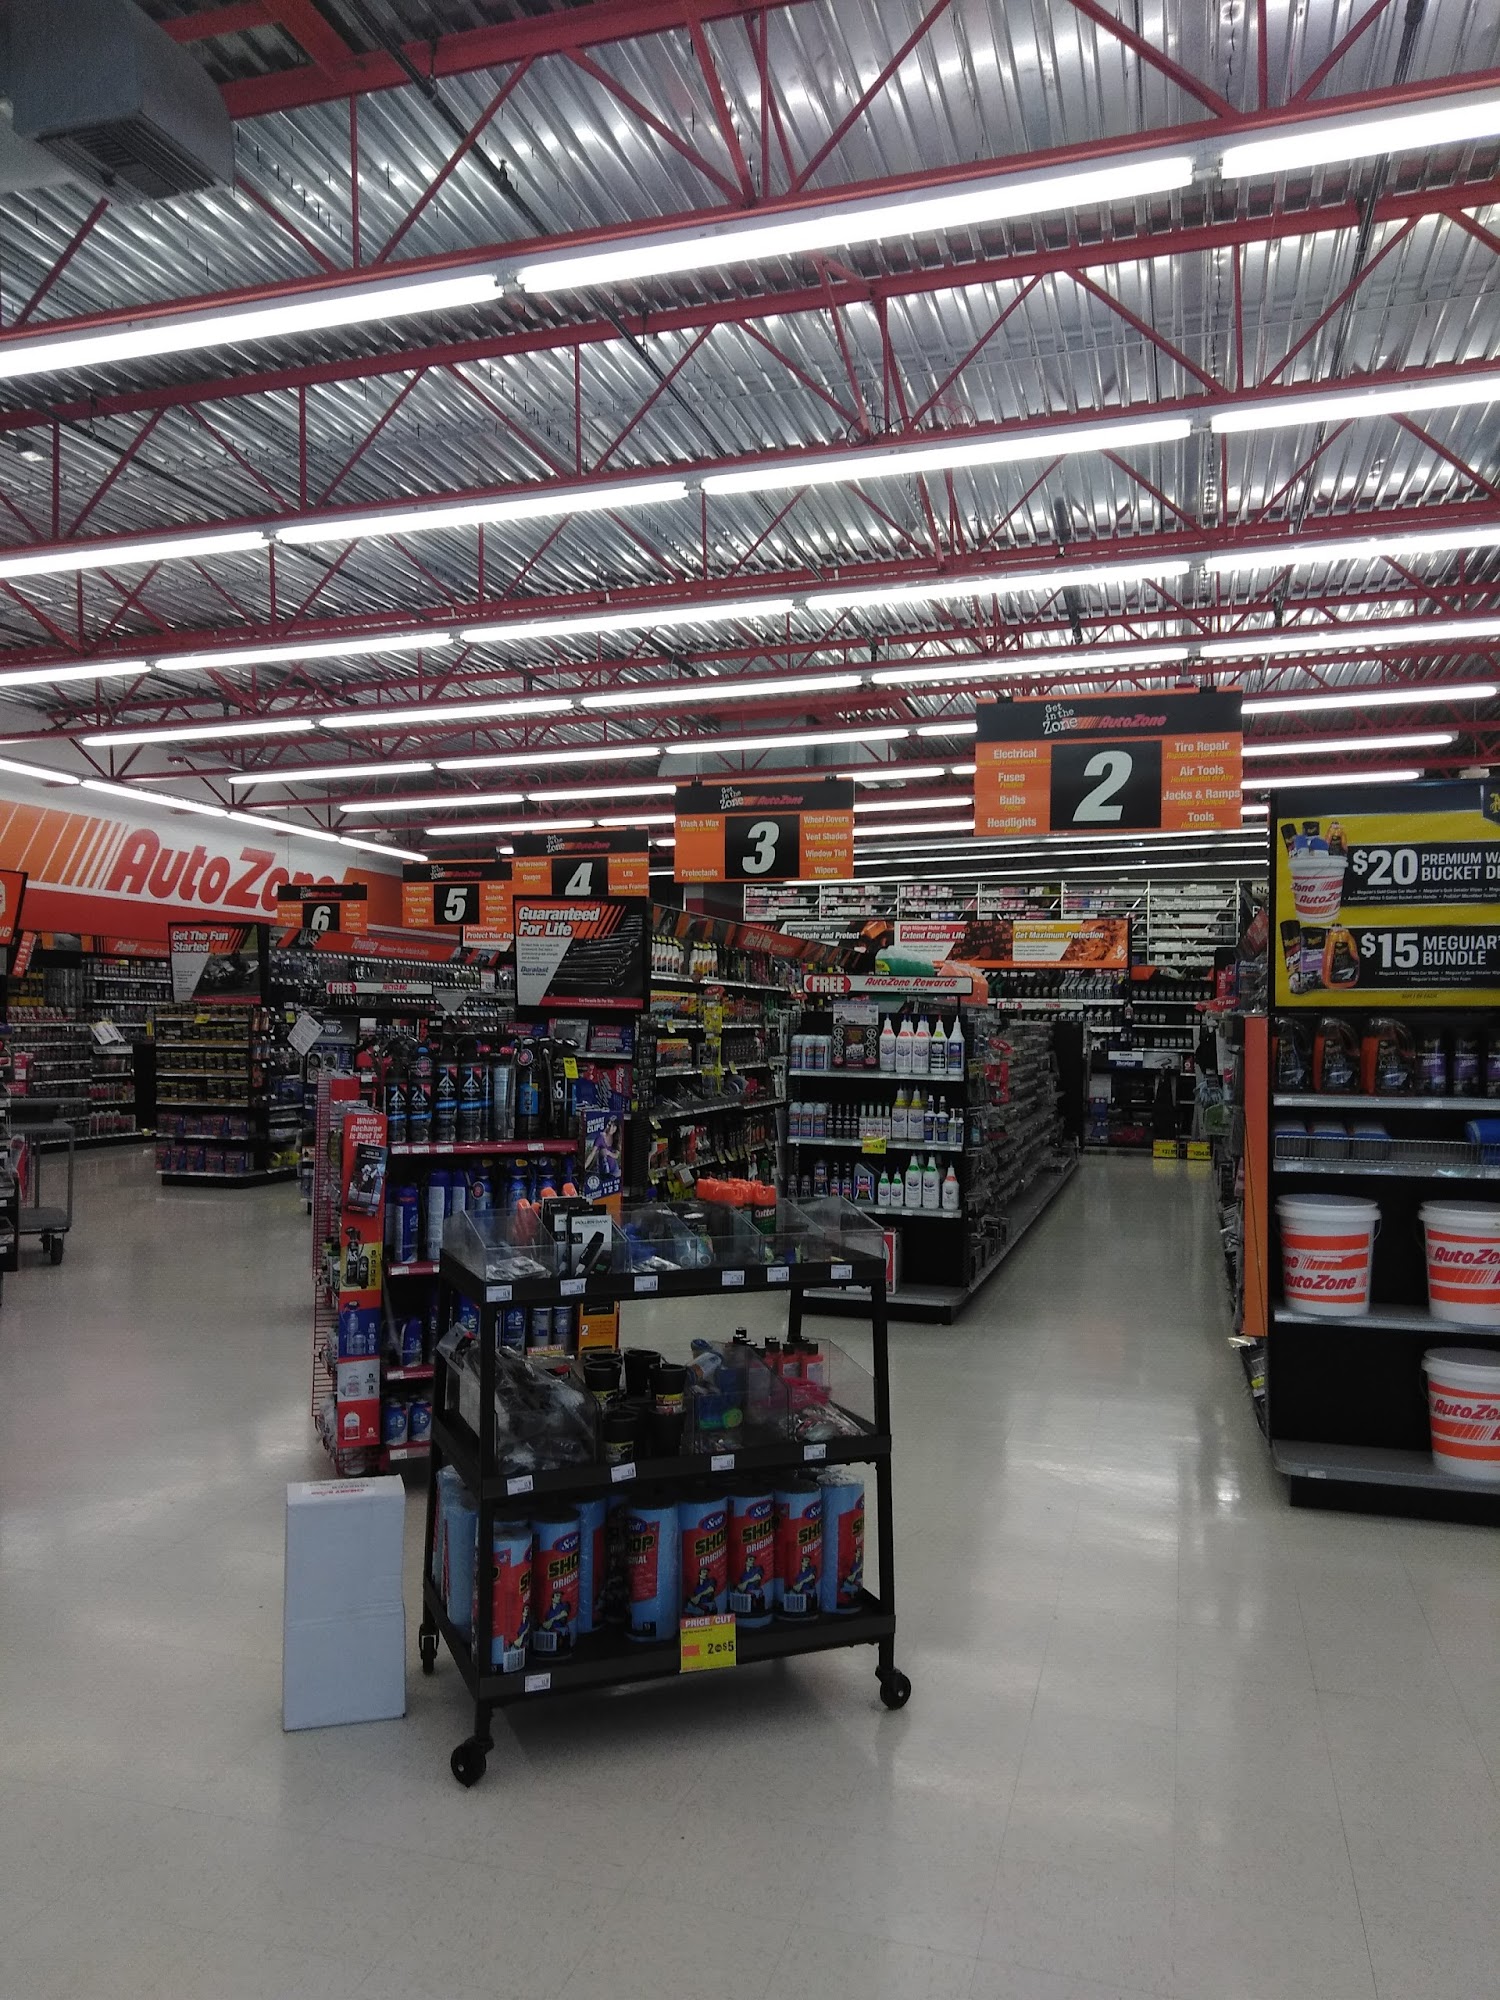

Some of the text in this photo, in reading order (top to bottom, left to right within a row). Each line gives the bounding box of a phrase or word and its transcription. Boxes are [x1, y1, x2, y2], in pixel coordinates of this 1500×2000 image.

[1045, 703, 1062, 713] Get
[1045, 708, 1074, 721] in the
[1042, 714, 1167, 734] Zone AutoZone
[1175, 740, 1230, 753] Tire Repair
[993, 748, 1037, 759] Electrical
[1180, 765, 1224, 776] Air Tools
[998, 772, 1025, 782] Fuses
[1072, 750, 1133, 822] 2
[999, 795, 1026, 805] Bulbs
[1163, 789, 1241, 800] Jacks & Ramps
[826, 815, 849, 823] Covers
[1187, 811, 1214, 822] Tools
[680, 820, 697, 828] Wash
[705, 819, 720, 827] Wax
[987, 817, 1037, 828] Headlights
[822, 832, 848, 840] Shades
[742, 821, 780, 874] 3
[806, 849, 832, 857] Window
[1421, 852, 1500, 866] PREMIUM W
[104, 828, 336, 912] AutoZo
[814, 866, 838, 874] Wipers
[1352, 848, 1419, 886] $20
[681, 869, 717, 877] Protectants
[1421, 865, 1500, 881] BUCKET D
[565, 862, 593, 896] 4
[444, 887, 468, 922] 5
[311, 905, 331, 931] 6
[518, 905, 600, 921] Guaranteed
[518, 922, 573, 936] For Life
[173, 930, 229, 940] Get The Fun
[835, 932, 860, 940] Protect
[926, 932, 950, 940] Engine
[951, 931, 966, 939] Life
[1030, 931, 1064, 939] Maximum
[1066, 931, 1105, 939] Protection
[173, 941, 209, 952] Started
[1361, 932, 1419, 968] $15
[1422, 950, 1487, 966] BUNDLE
[812, 976, 844, 992] FREE
[865, 977, 958, 987] AutoZone Rewards
[331, 983, 353, 993] FREE
[356, 1117, 377, 1125] Which
[586, 1124, 605, 1134] CLIPS
[356, 1132, 373, 1140] Best
[755, 1207, 776, 1218] Cutter
[1435, 1247, 1500, 1265] AutoZo
[1285, 1272, 1357, 1290] AutoZone
[581, 1324, 589, 1336] 2
[1434, 1399, 1500, 1420] AutoZo
[694, 1529, 728, 1557] SHO
[685, 1615, 731, 1628] PRICE CUT
[707, 1641, 734, 1655] 2 $5
